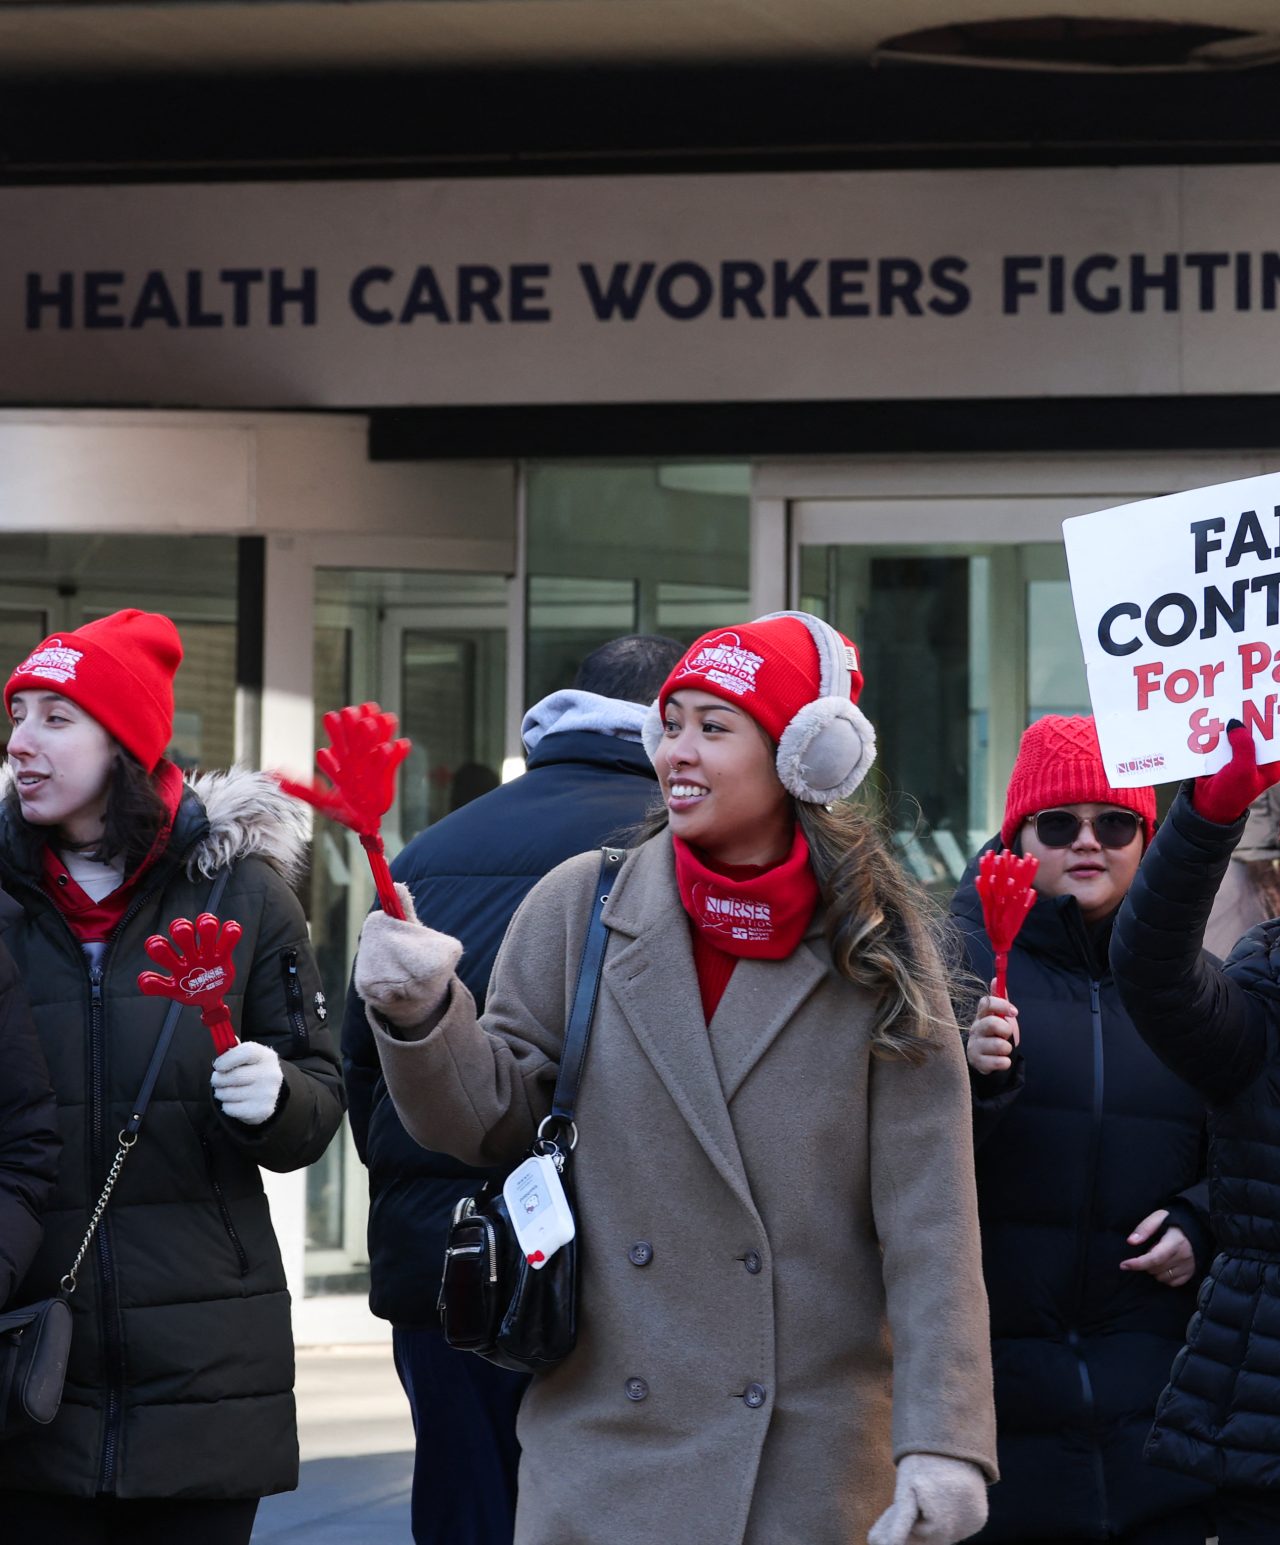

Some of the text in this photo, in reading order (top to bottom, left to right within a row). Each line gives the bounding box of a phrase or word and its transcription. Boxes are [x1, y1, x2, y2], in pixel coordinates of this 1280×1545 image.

[26, 267, 318, 331] HEALTH
[350, 262, 552, 326] CARE
[578, 256, 971, 322] WORKERS
[696, 648, 761, 675] NURSES
[1134, 661, 1225, 711] For
[1188, 708, 1225, 754] &
[1116, 757, 1165, 774] NURSES
[705, 896, 771, 920] NURSES
